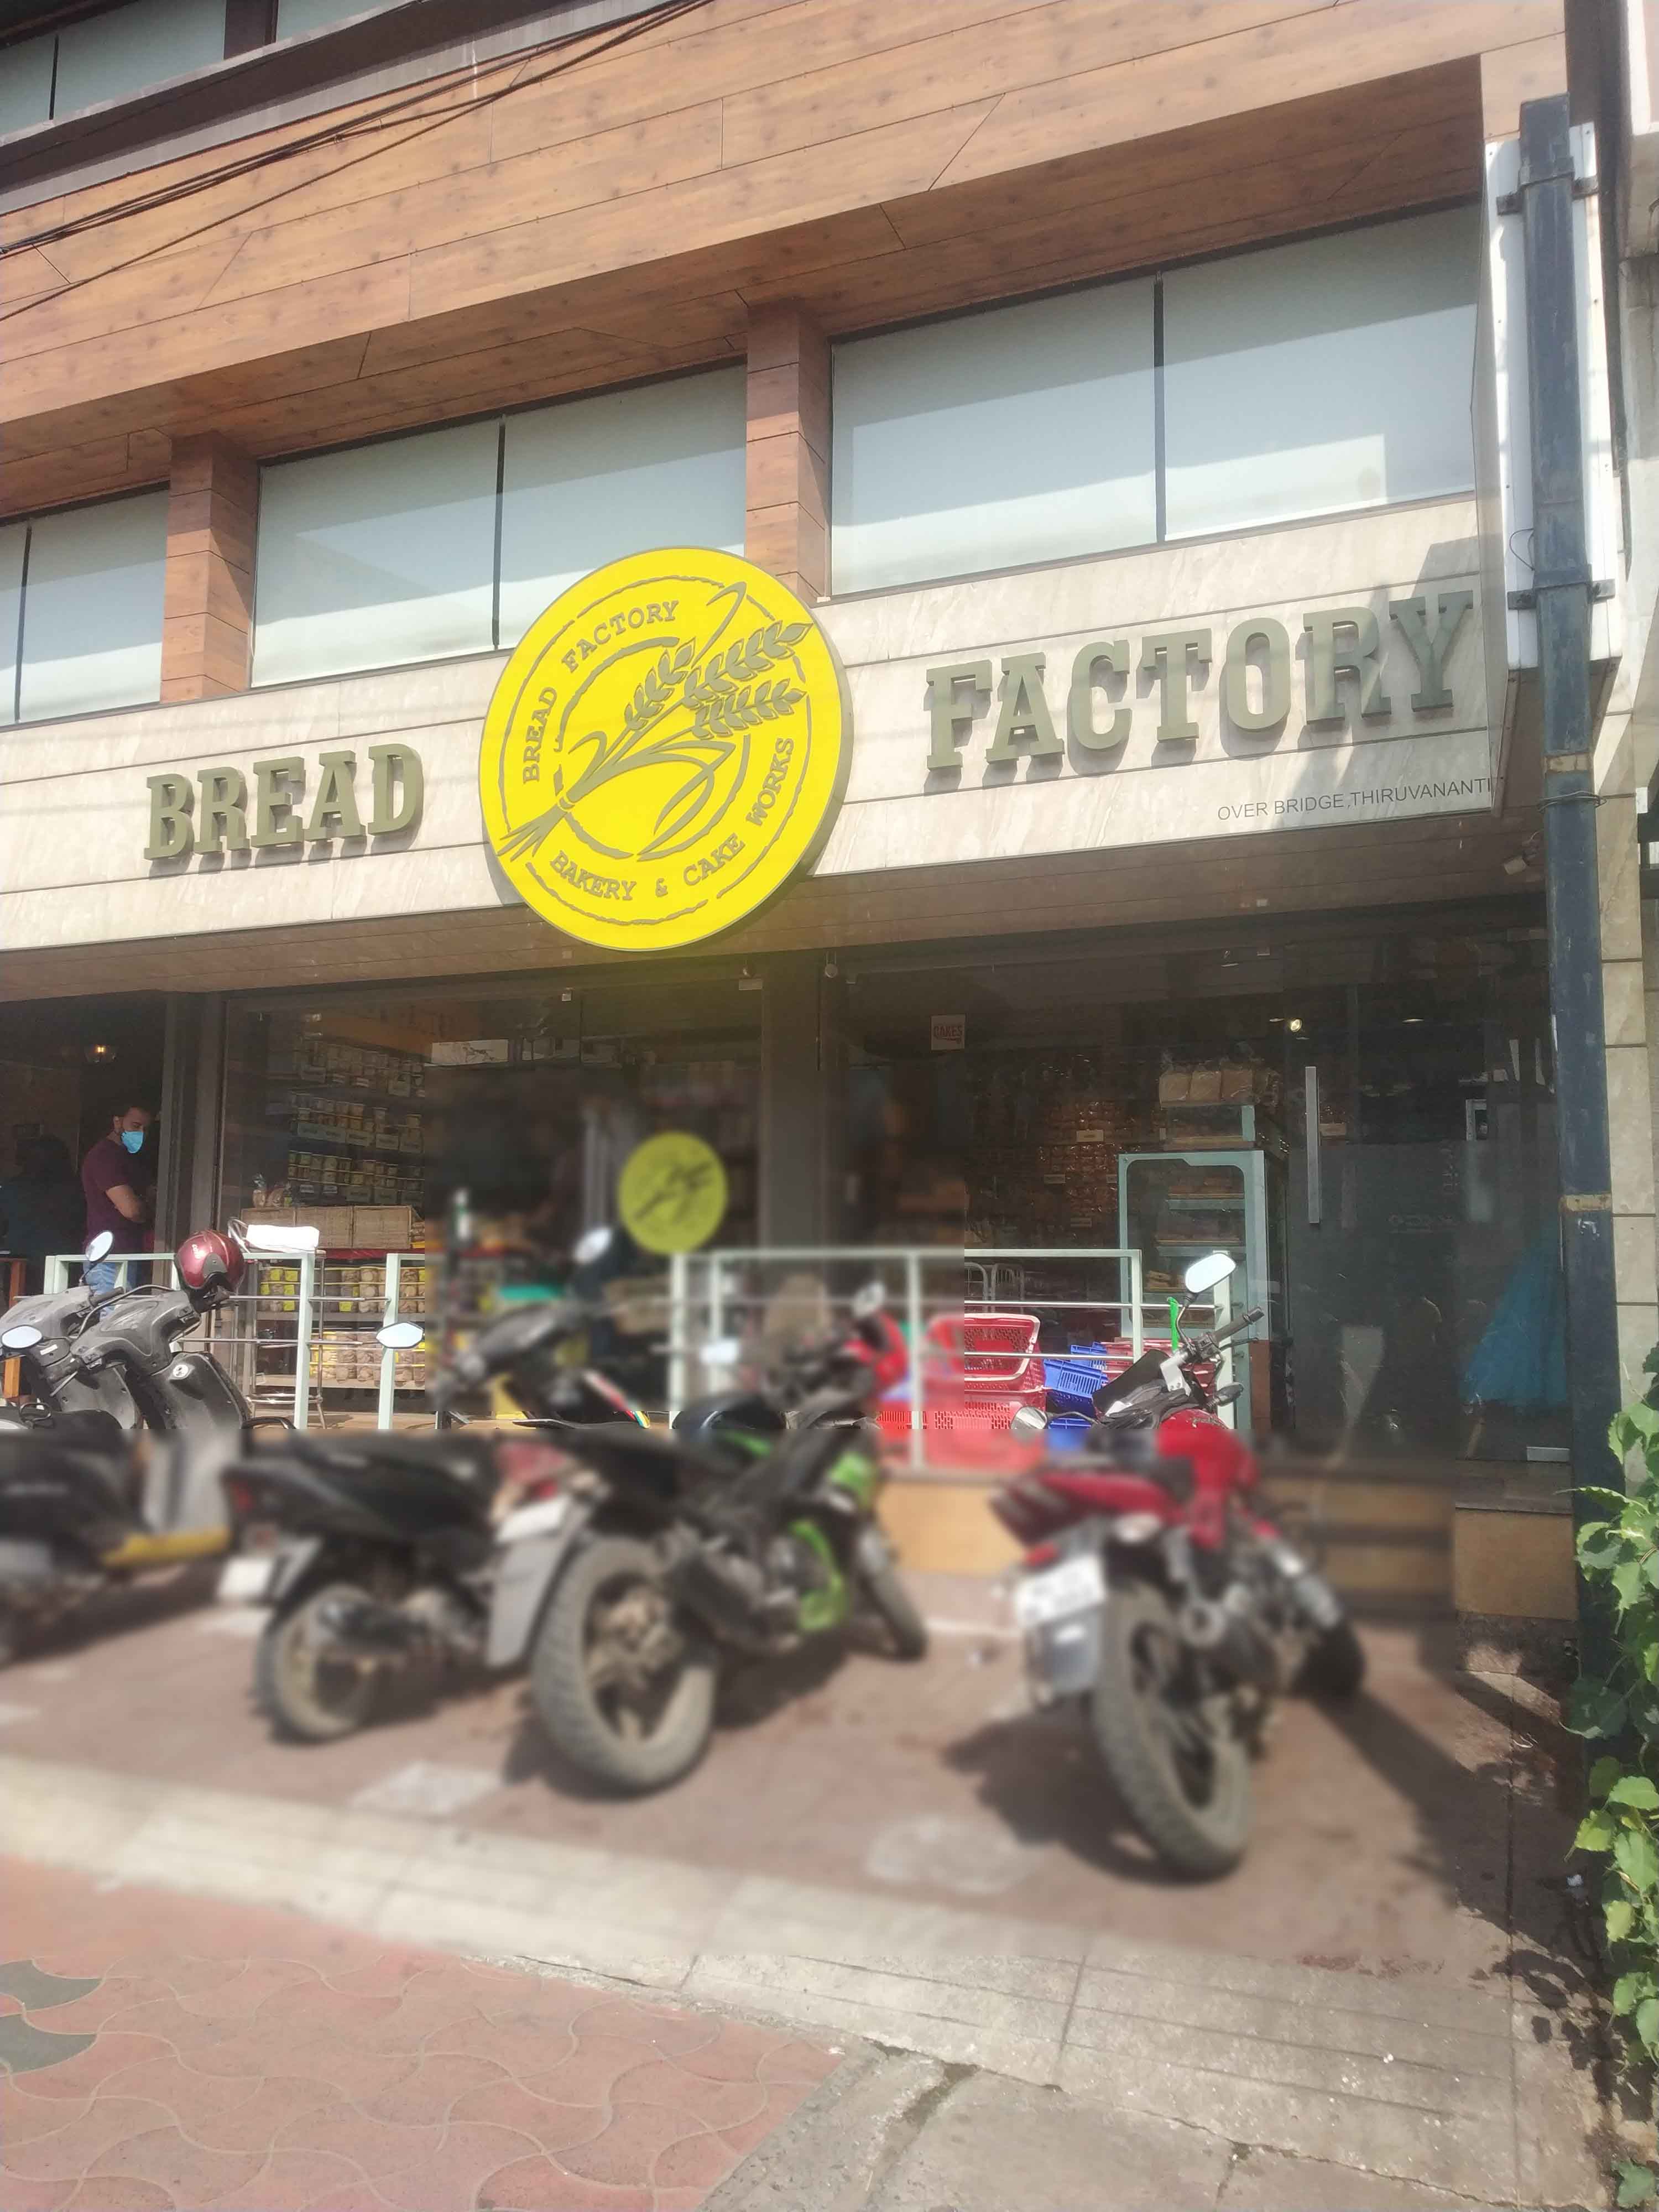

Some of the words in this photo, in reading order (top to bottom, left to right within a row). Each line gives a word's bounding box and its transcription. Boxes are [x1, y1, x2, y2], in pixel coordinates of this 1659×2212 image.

[144, 743, 424, 860] BREAD
[926, 589, 1474, 770] FACTORY
[523, 686, 557, 784] BREAD
[561, 599, 680, 673] FACTORY
[549, 849, 637, 901] BAKERY
[655, 878, 669, 898] &
[683, 833, 745, 886] CAKE
[745, 737, 795, 827] WORKS
[1217, 802, 1268, 820] OVER
